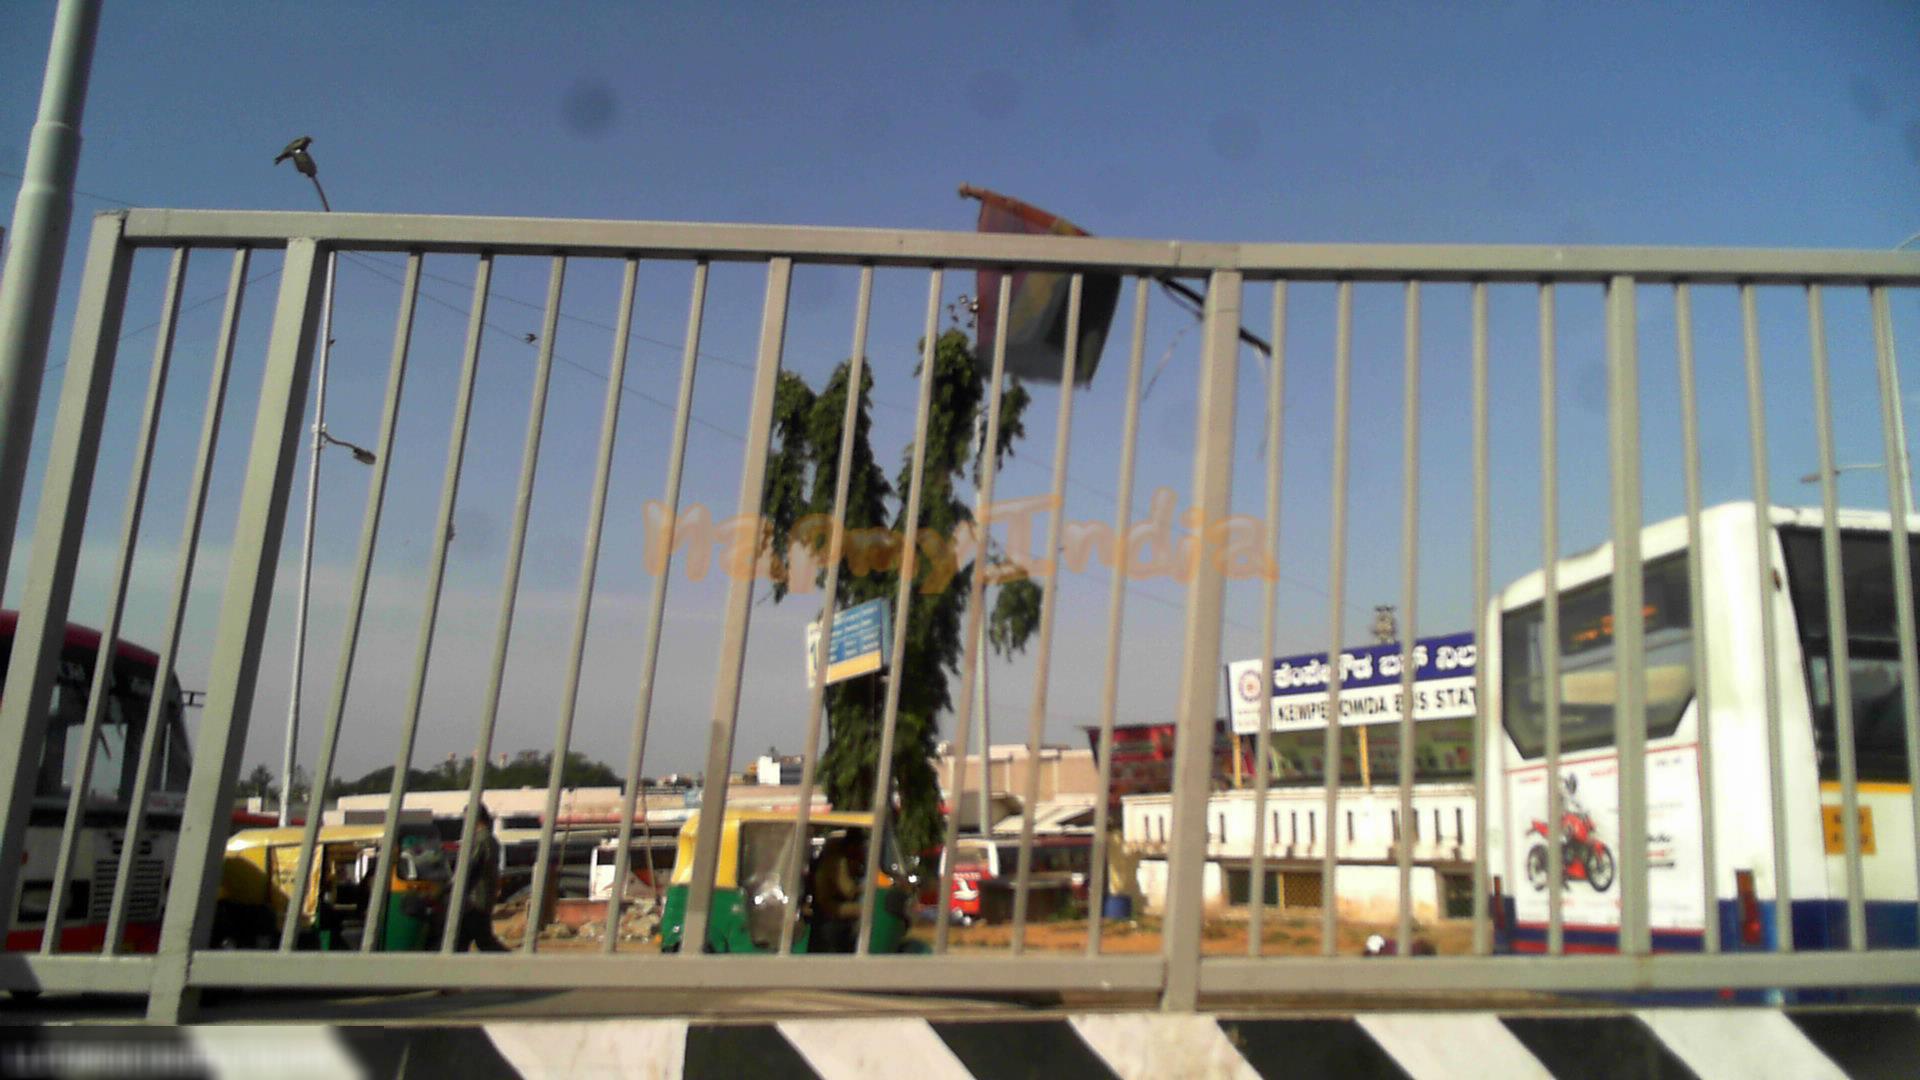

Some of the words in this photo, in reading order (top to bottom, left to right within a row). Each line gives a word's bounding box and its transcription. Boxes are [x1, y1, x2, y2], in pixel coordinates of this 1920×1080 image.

[1277, 696, 1388, 722] KEMPEOWDA
[1395, 691, 1428, 713] BS
[1435, 687, 1477, 708] STAT
